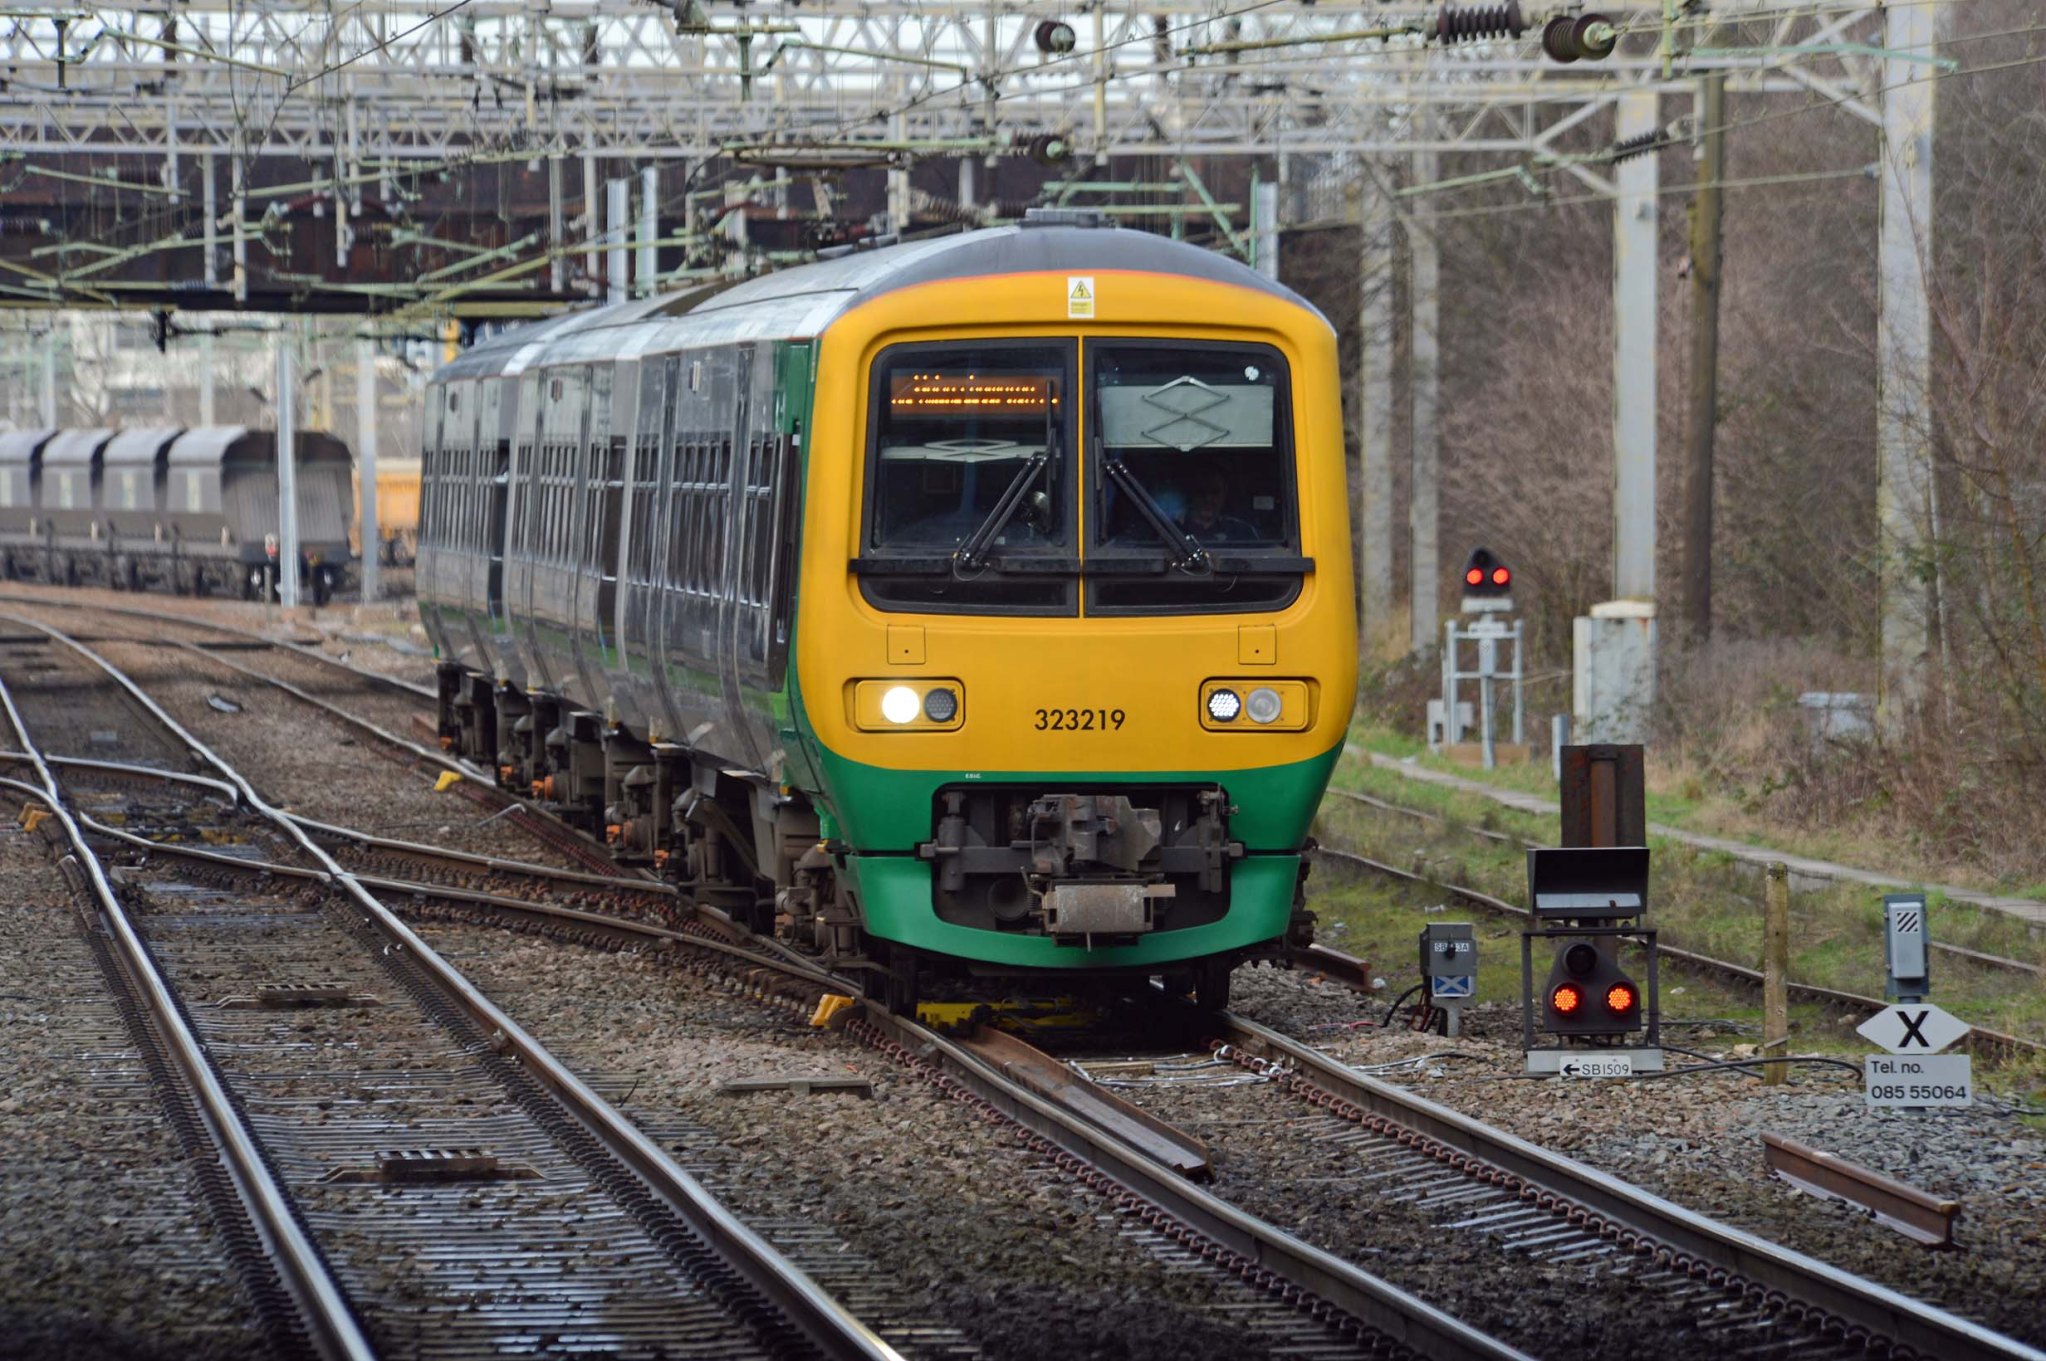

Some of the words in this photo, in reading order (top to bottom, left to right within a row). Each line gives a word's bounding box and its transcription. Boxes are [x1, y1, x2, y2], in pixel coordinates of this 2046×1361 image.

[1034, 708, 1126, 731] 323219
[1895, 1010, 1930, 1048] X
[1582, 1063, 1629, 1076] SB1509
[1871, 1060, 1898, 1074] Tel.
[1901, 1062, 1924, 1074] no.
[1871, 1085, 1905, 1099] 085
[1909, 1085, 1967, 1099] 55064
